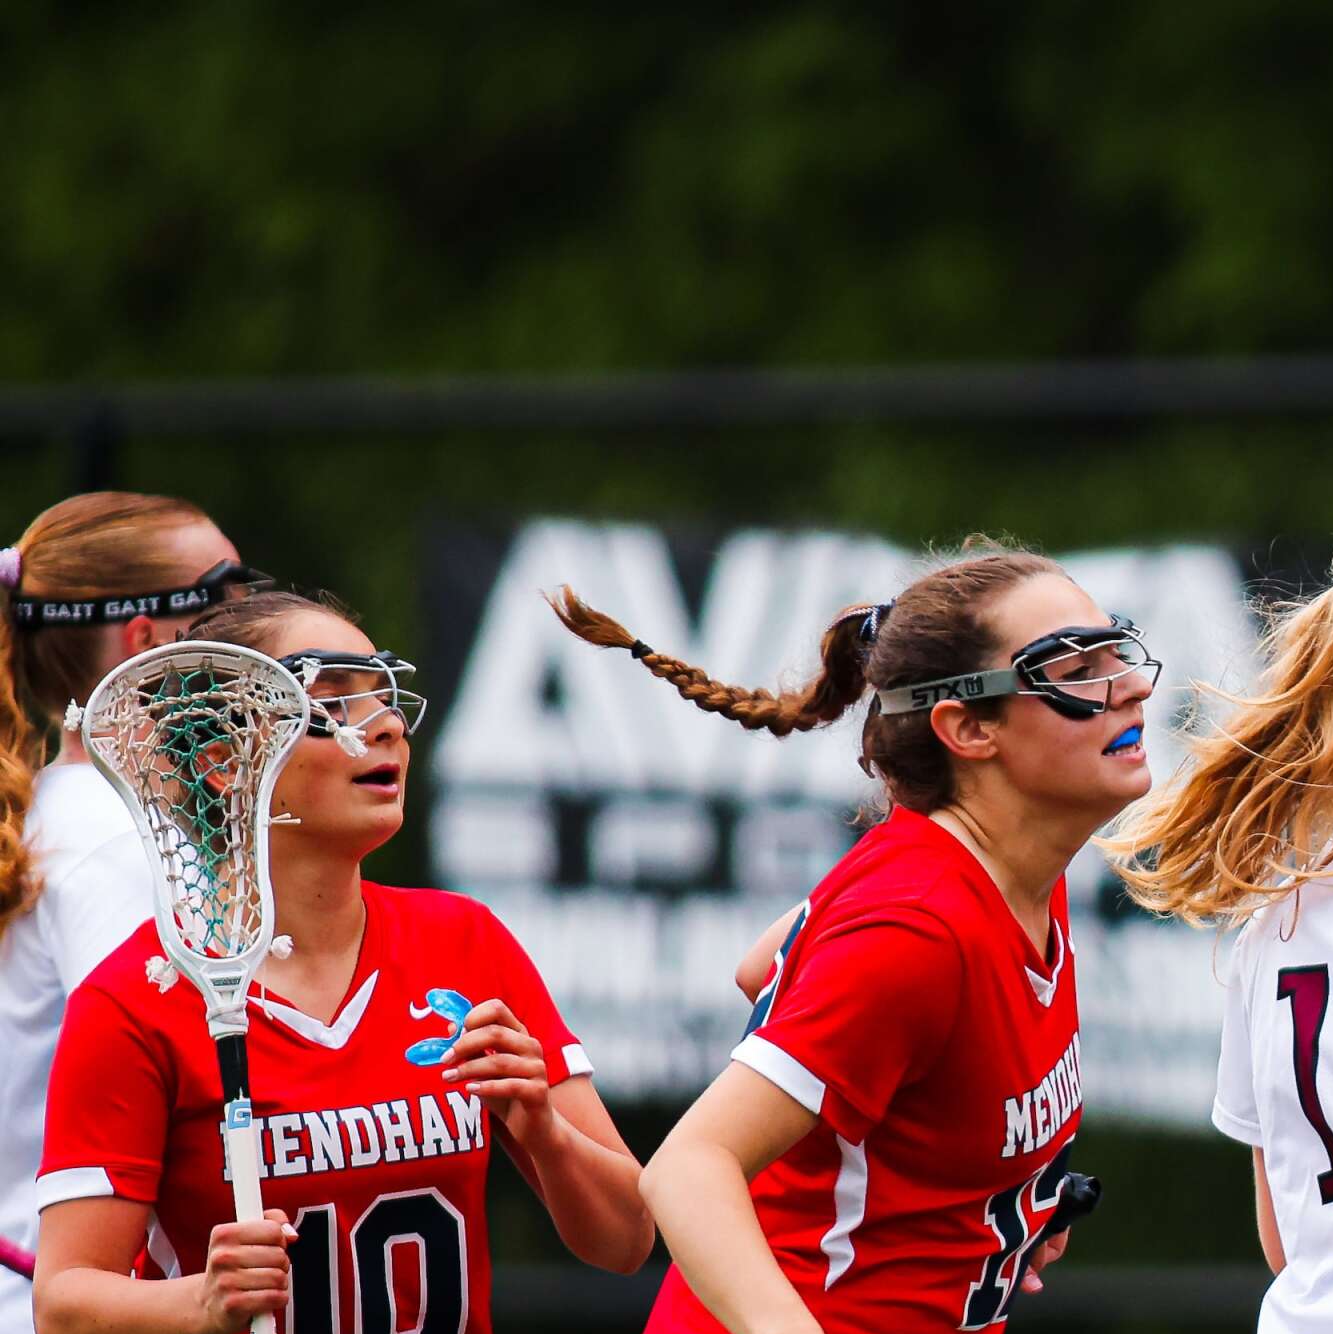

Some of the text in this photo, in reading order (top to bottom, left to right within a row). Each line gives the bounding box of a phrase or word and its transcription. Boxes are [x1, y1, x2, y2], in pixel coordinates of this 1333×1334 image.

[42, 603, 95, 618] GAIT
[105, 596, 160, 617] GAIT
[912, 680, 963, 708] STX
[1001, 1031, 1082, 1158] MENDH
